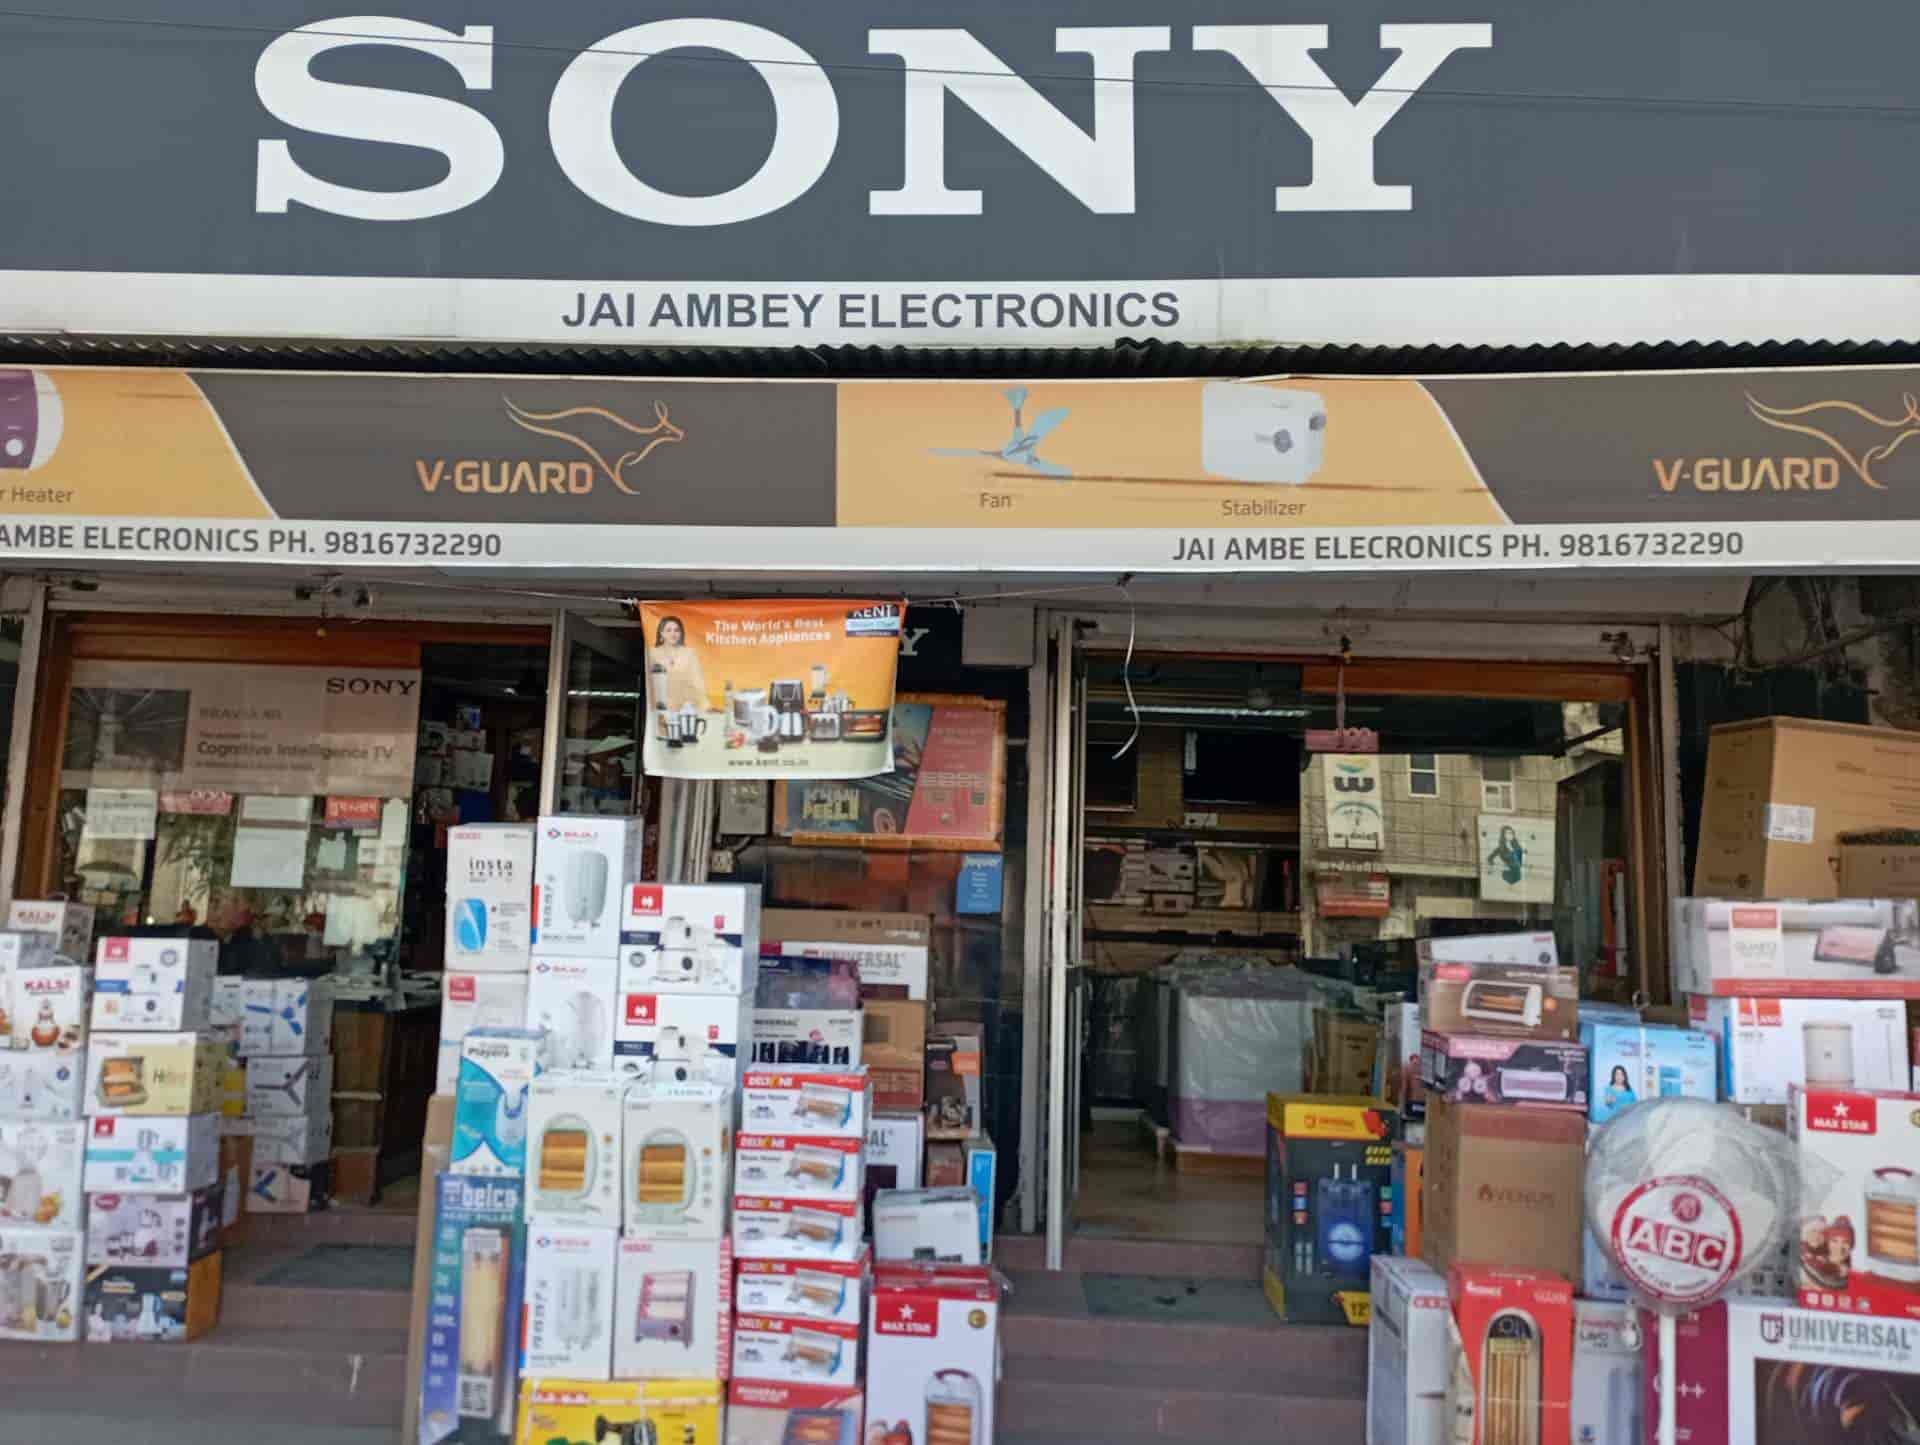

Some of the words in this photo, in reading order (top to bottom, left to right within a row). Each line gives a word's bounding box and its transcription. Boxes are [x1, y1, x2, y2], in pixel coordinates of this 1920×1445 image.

[255, 16, 1493, 227] SONY
[562, 293, 635, 328] JAI
[649, 293, 824, 328] AMBEY
[838, 291, 1181, 329] ELECTRONICS
[415, 459, 594, 495] V-GUARD
[1652, 456, 1840, 491] V-GUARD
[11, 486, 73, 503] Heater
[979, 492, 1012, 508] Fan
[1221, 499, 1307, 518] Stabilizer
[0, 524, 74, 549] AMBE
[84, 526, 259, 552] ELECRONICS
[267, 529, 315, 554] PH.
[324, 531, 501, 557] 9816732290
[1173, 537, 1215, 561] JAI
[1224, 537, 1305, 561] AMBE
[1315, 535, 1492, 560] ELECRONICS
[1502, 534, 1550, 558] PH.
[1559, 531, 1744, 557] 9816732290
[713, 620, 738, 633] The
[326, 677, 417, 696] SONY
[1629, 1218, 1724, 1270] ABC
[1788, 1315, 1913, 1350] UNIVERSAL
